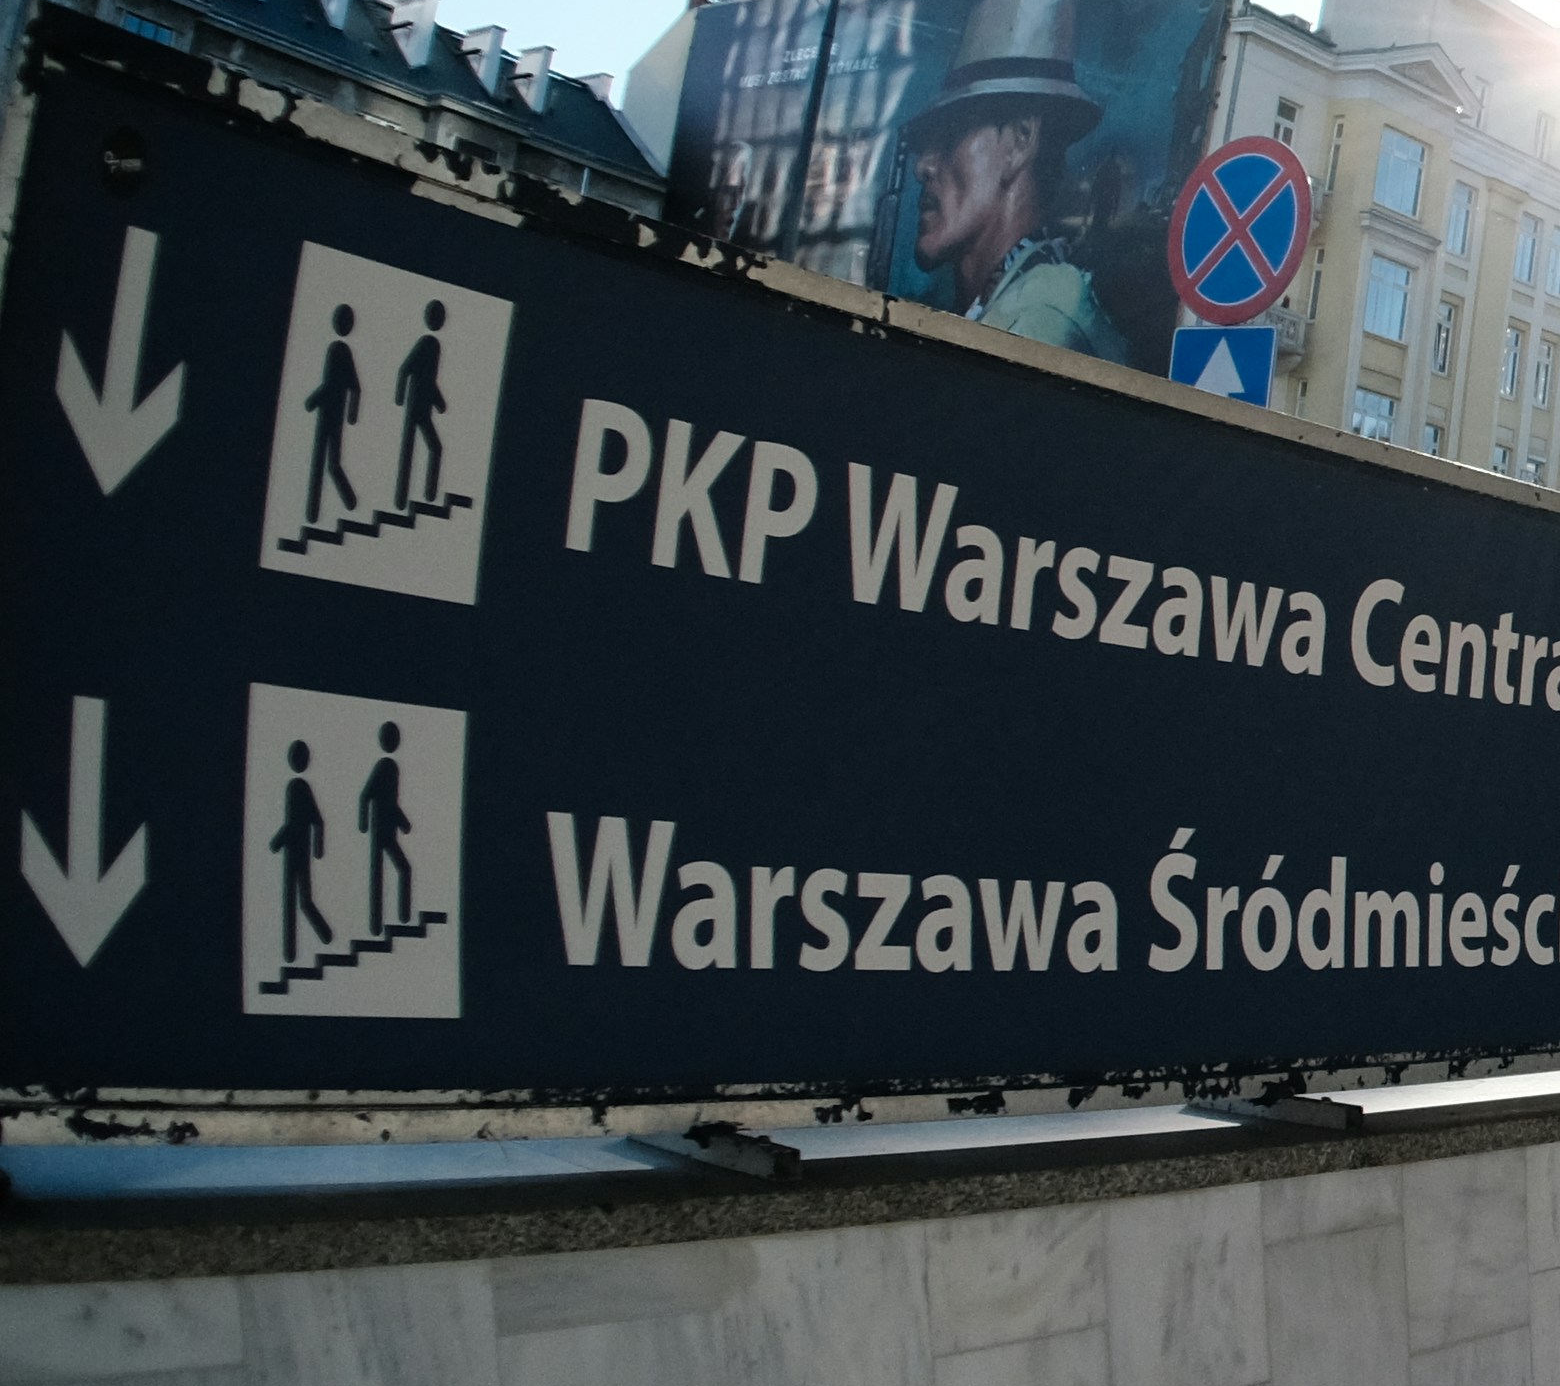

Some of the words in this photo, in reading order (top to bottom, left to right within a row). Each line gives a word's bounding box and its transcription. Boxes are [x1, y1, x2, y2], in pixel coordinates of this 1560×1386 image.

[566, 398, 819, 585] PKP
[848, 462, 1327, 677] Warszawa
[547, 811, 1119, 973] Warszawa
